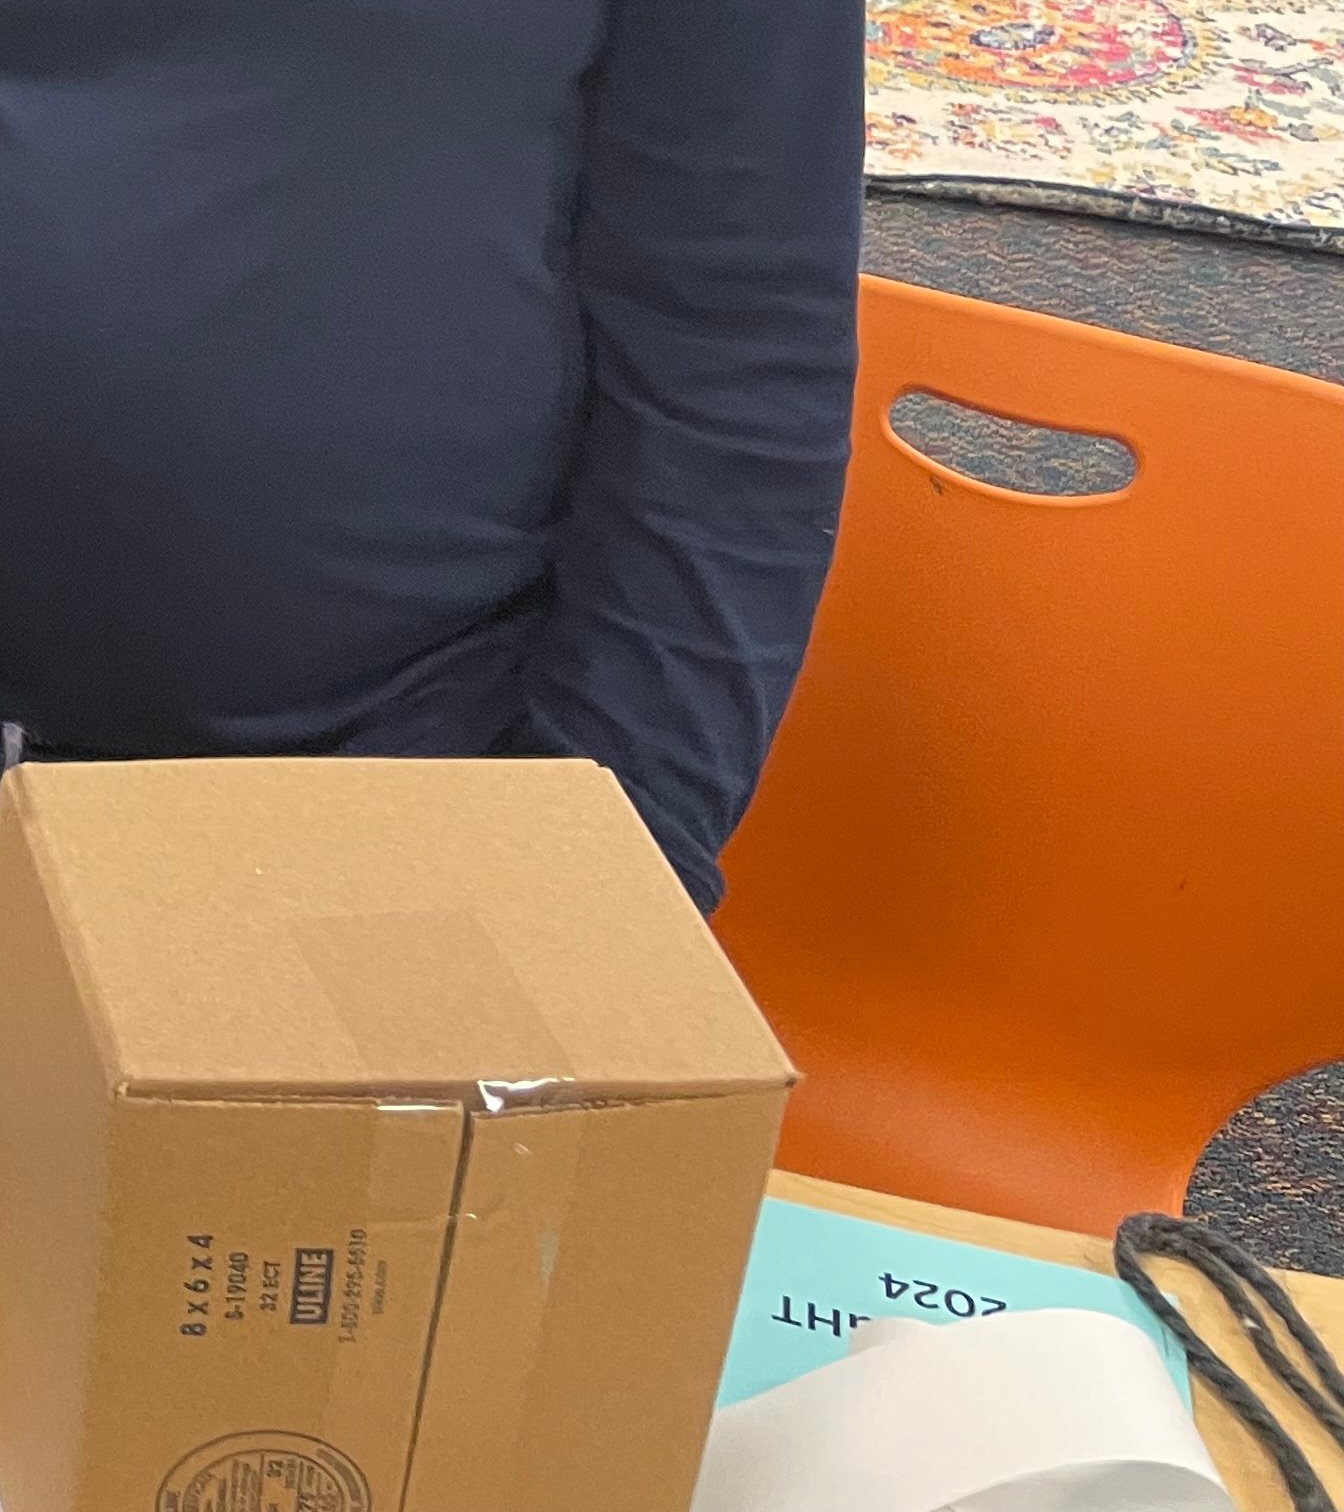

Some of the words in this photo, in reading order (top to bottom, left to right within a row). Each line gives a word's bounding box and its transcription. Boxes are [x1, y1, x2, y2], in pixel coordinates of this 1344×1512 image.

[187, 1234, 214, 1249] 4
[191, 1256, 213, 1270] x
[264, 1260, 281, 1289] ECT
[183, 1278, 210, 1293] 6
[296, 1251, 327, 1321] ULINE
[187, 1301, 209, 1316] x
[179, 1322, 207, 1337] 8
